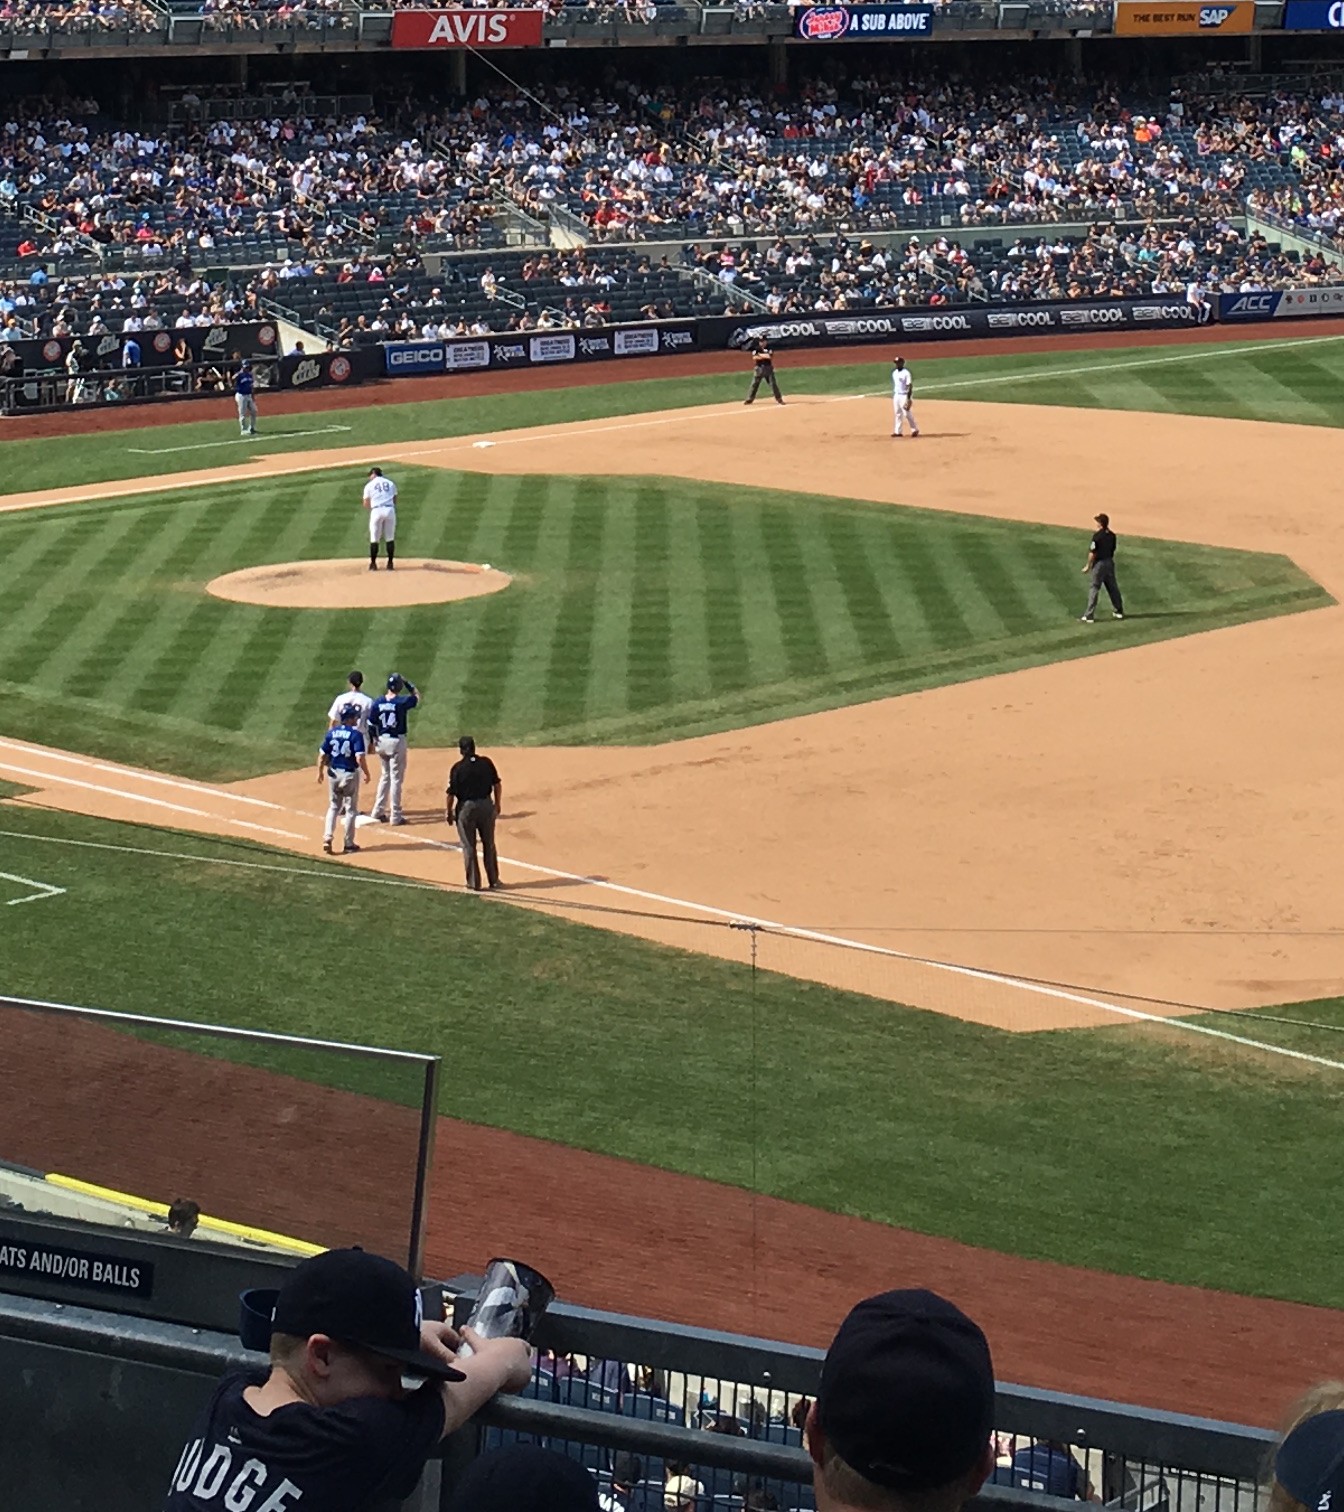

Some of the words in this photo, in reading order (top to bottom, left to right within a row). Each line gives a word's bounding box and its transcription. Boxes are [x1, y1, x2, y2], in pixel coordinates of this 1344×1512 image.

[849, 14, 859, 31] A
[861, 14, 886, 31] SUB
[887, 13, 926, 30] ABOVE
[1199, 9, 1229, 25] SAP
[427, 14, 509, 43] AVIS
[1230, 295, 1273, 311] ACC
[932, 316, 971, 330] COOL
[1017, 311, 1056, 326] COOL
[1090, 308, 1127, 322] COOL
[779, 323, 820, 338] COOL
[857, 319, 896, 333] COOL
[390, 348, 444, 365] GEICO
[374, 481, 390, 493] 48
[378, 712, 398, 728] 14
[329, 739, 352, 757] 34
[29, 1250, 88, 1279] AND/OR
[92, 1260, 140, 1289] BALLS
